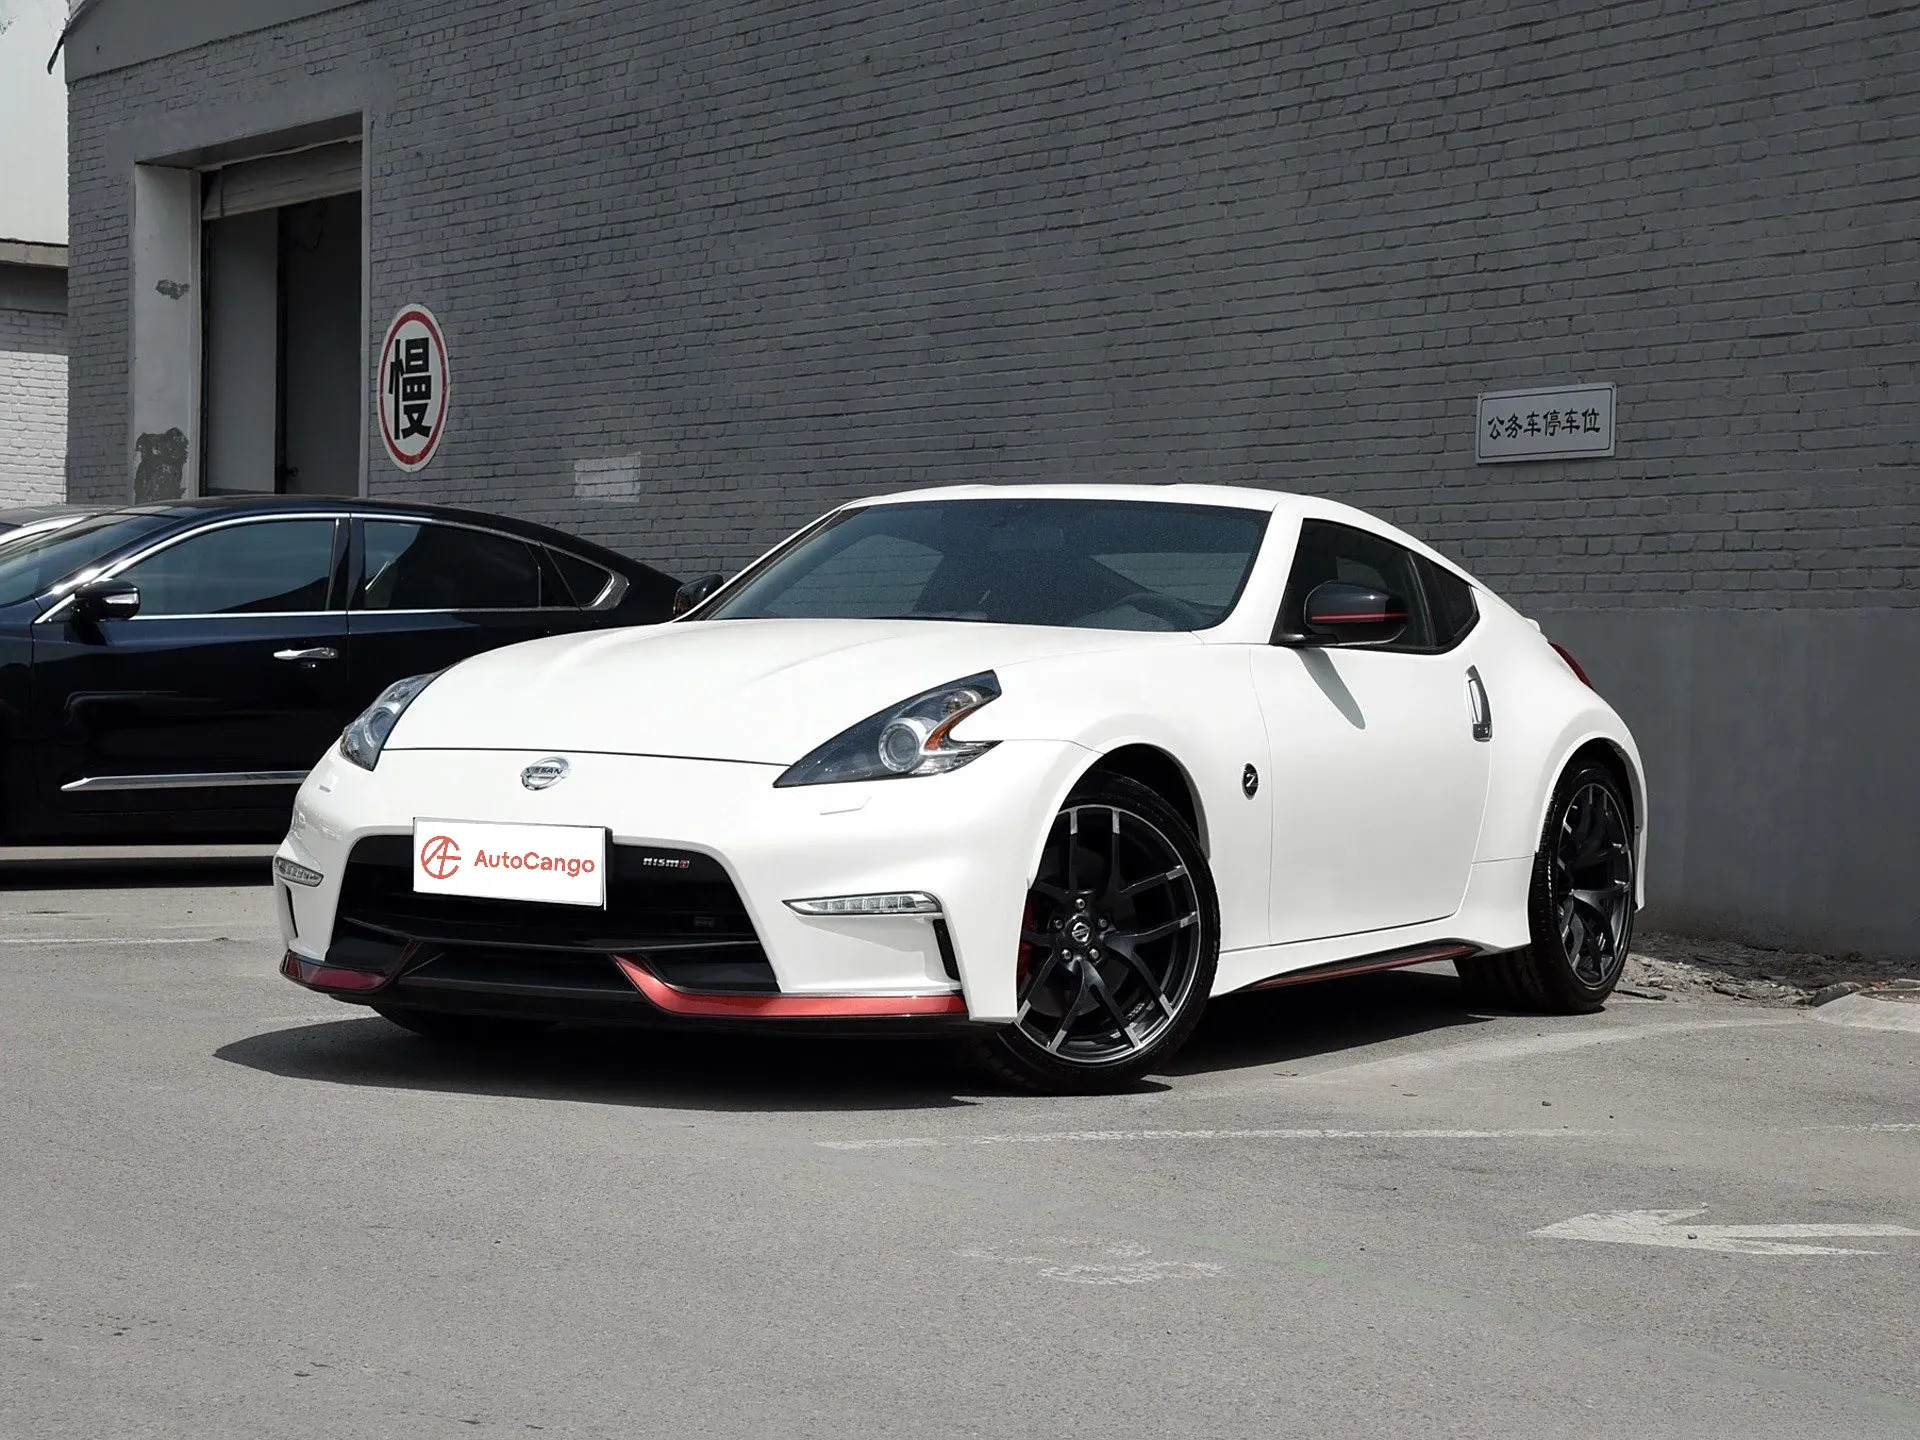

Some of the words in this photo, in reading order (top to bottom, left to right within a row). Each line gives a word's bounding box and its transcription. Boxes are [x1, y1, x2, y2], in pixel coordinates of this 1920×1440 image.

[389, 337, 432, 440] 慢
[1488, 407, 1601, 440] 公务车停车位
[525, 766, 564, 774] NISSAN
